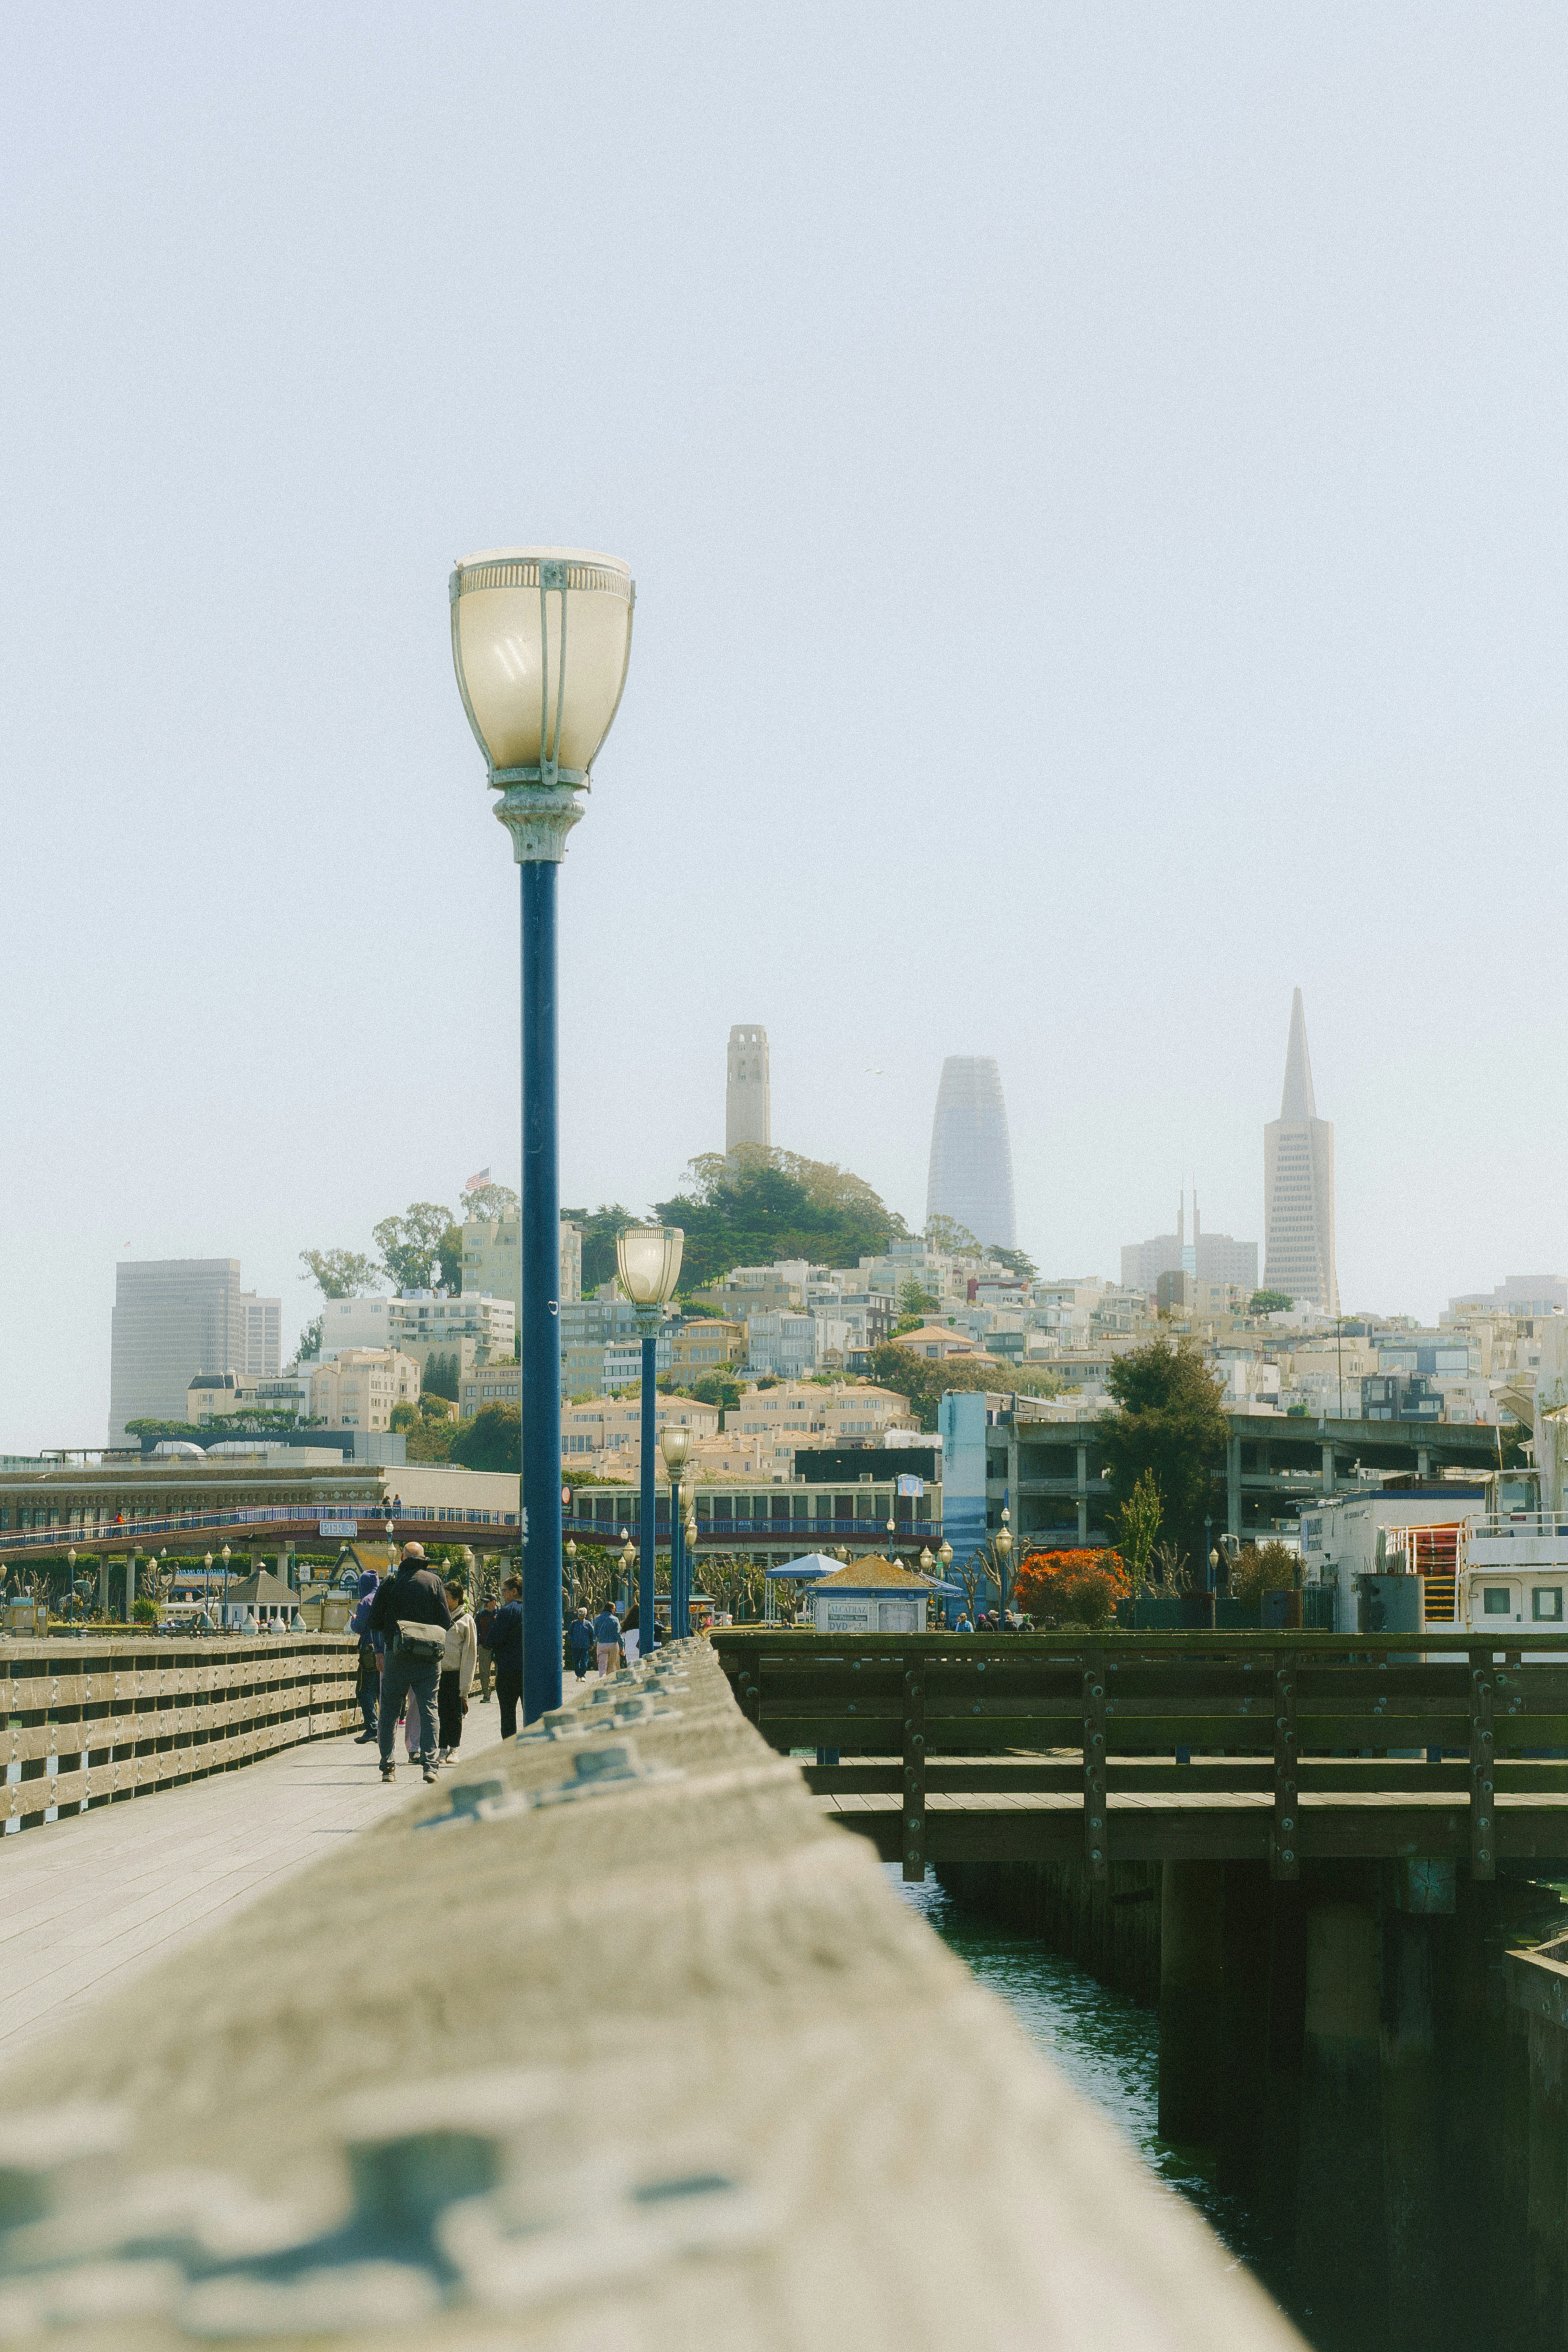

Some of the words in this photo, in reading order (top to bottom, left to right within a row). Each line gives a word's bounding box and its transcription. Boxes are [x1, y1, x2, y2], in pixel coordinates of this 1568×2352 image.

[322, 1523, 343, 1534] PIER
[346, 1524, 356, 1534] 39
[829, 1622, 848, 1630] DVD
